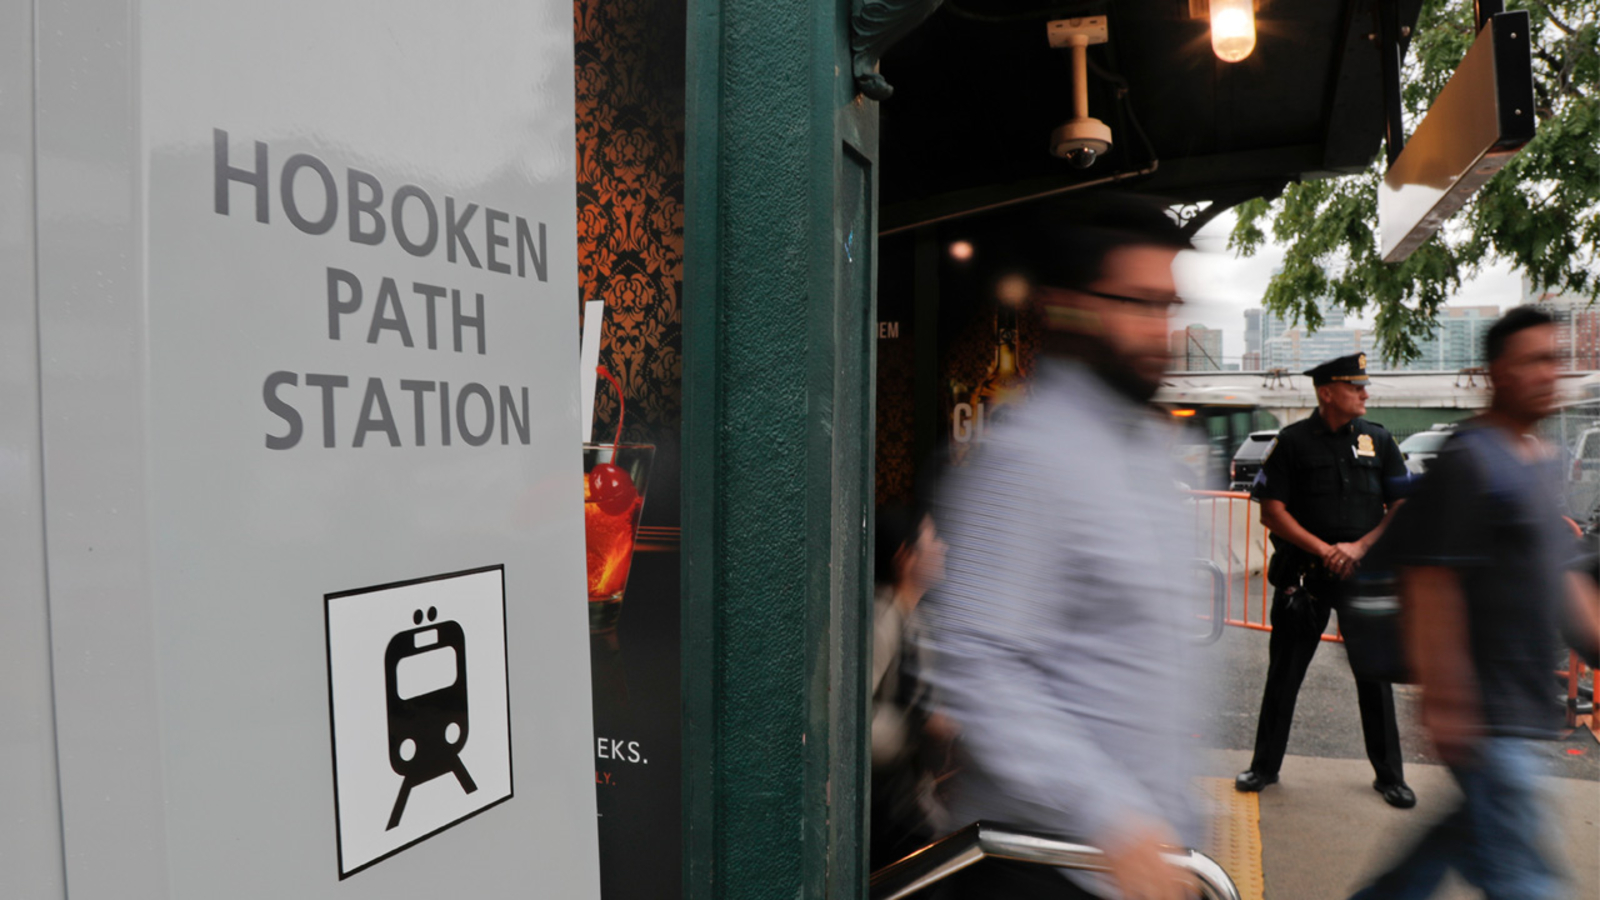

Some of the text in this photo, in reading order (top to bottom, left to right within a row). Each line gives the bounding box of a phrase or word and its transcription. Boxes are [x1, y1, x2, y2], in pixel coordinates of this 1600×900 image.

[213, 127, 548, 283] HOBOKEN
[326, 266, 486, 355] PATH
[262, 370, 531, 450] STATION
